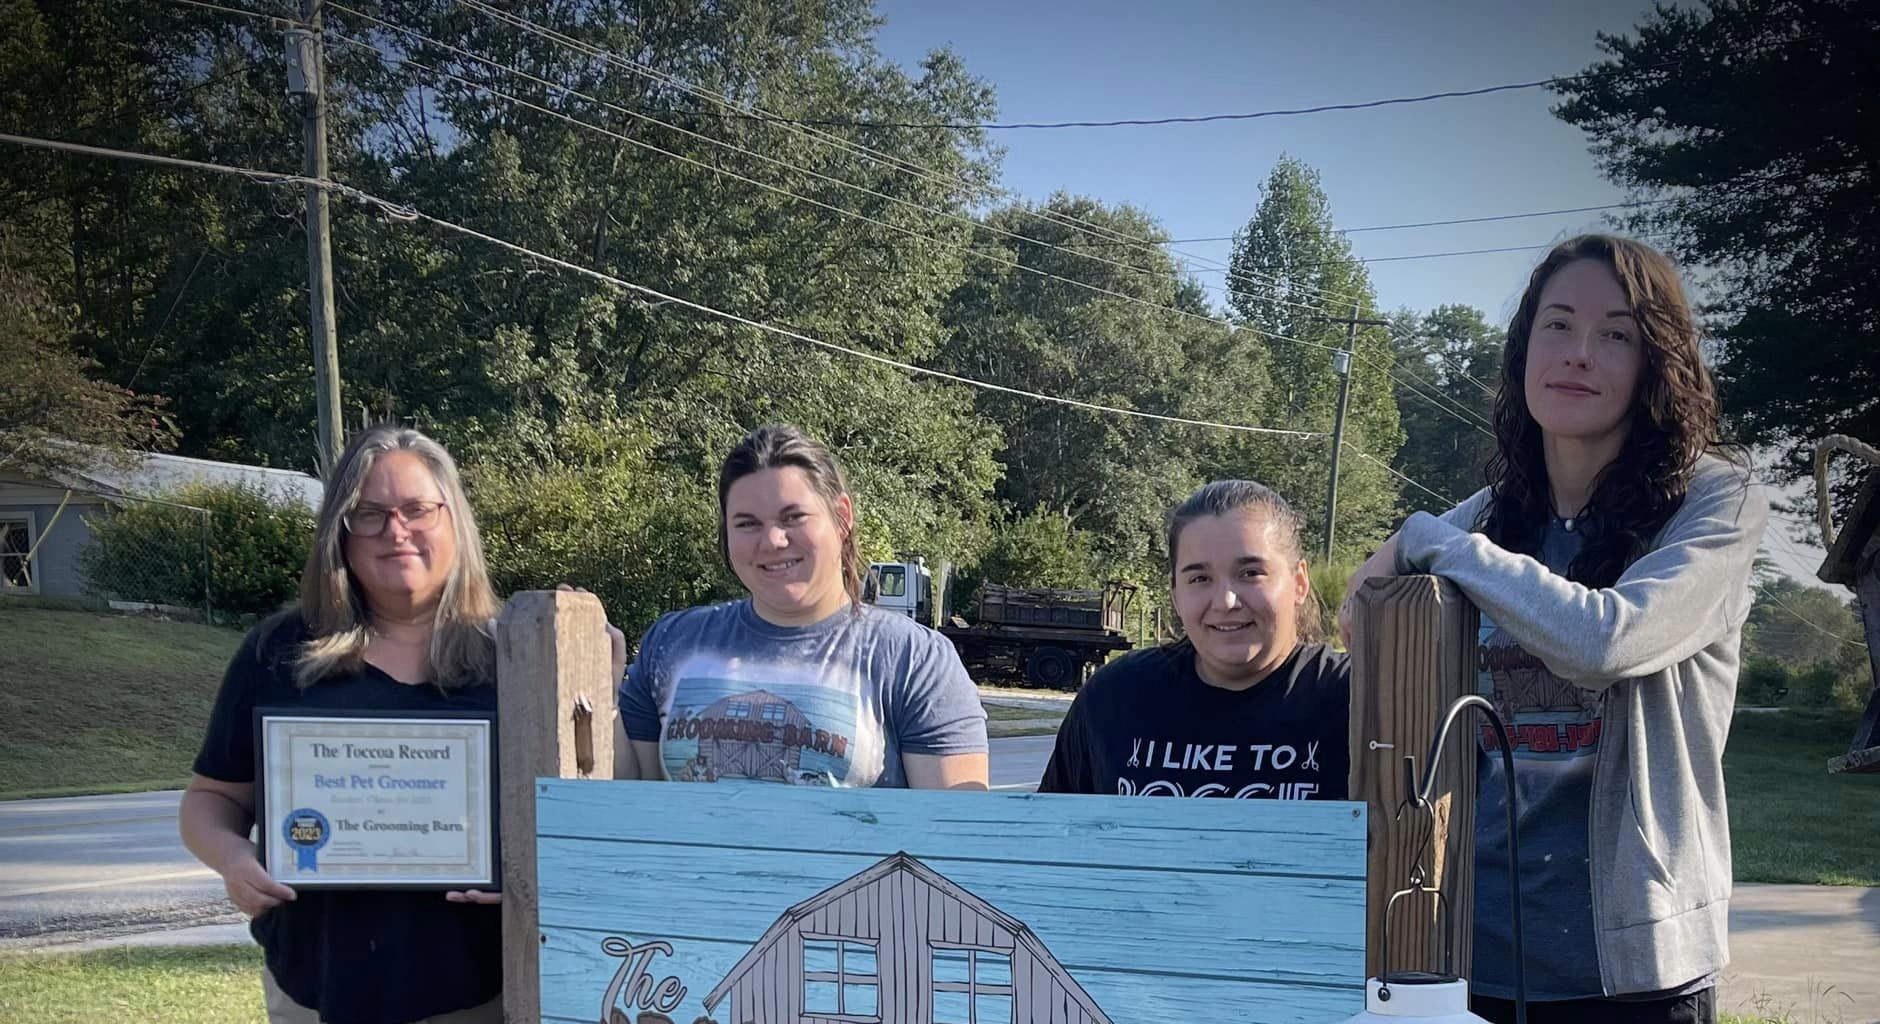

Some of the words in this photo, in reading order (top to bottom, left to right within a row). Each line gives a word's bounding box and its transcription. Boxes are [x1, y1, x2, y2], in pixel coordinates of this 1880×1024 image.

[667, 717, 774, 744] GROOMING
[783, 723, 848, 759] BARN
[310, 743, 338, 758] The
[345, 743, 395, 760] Toccoa
[399, 744, 451, 761] Record
[1146, 740, 1155, 767] I
[1162, 742, 1237, 771] LIKE
[1250, 744, 1297, 771] TO
[314, 774, 346, 789] Best
[351, 775, 374, 790] Pet
[378, 775, 447, 791] Groomer
[336, 819, 359, 832] The
[363, 820, 430, 835] Grooming
[433, 820, 464, 833] Barn
[601, 936, 688, 1024] The
